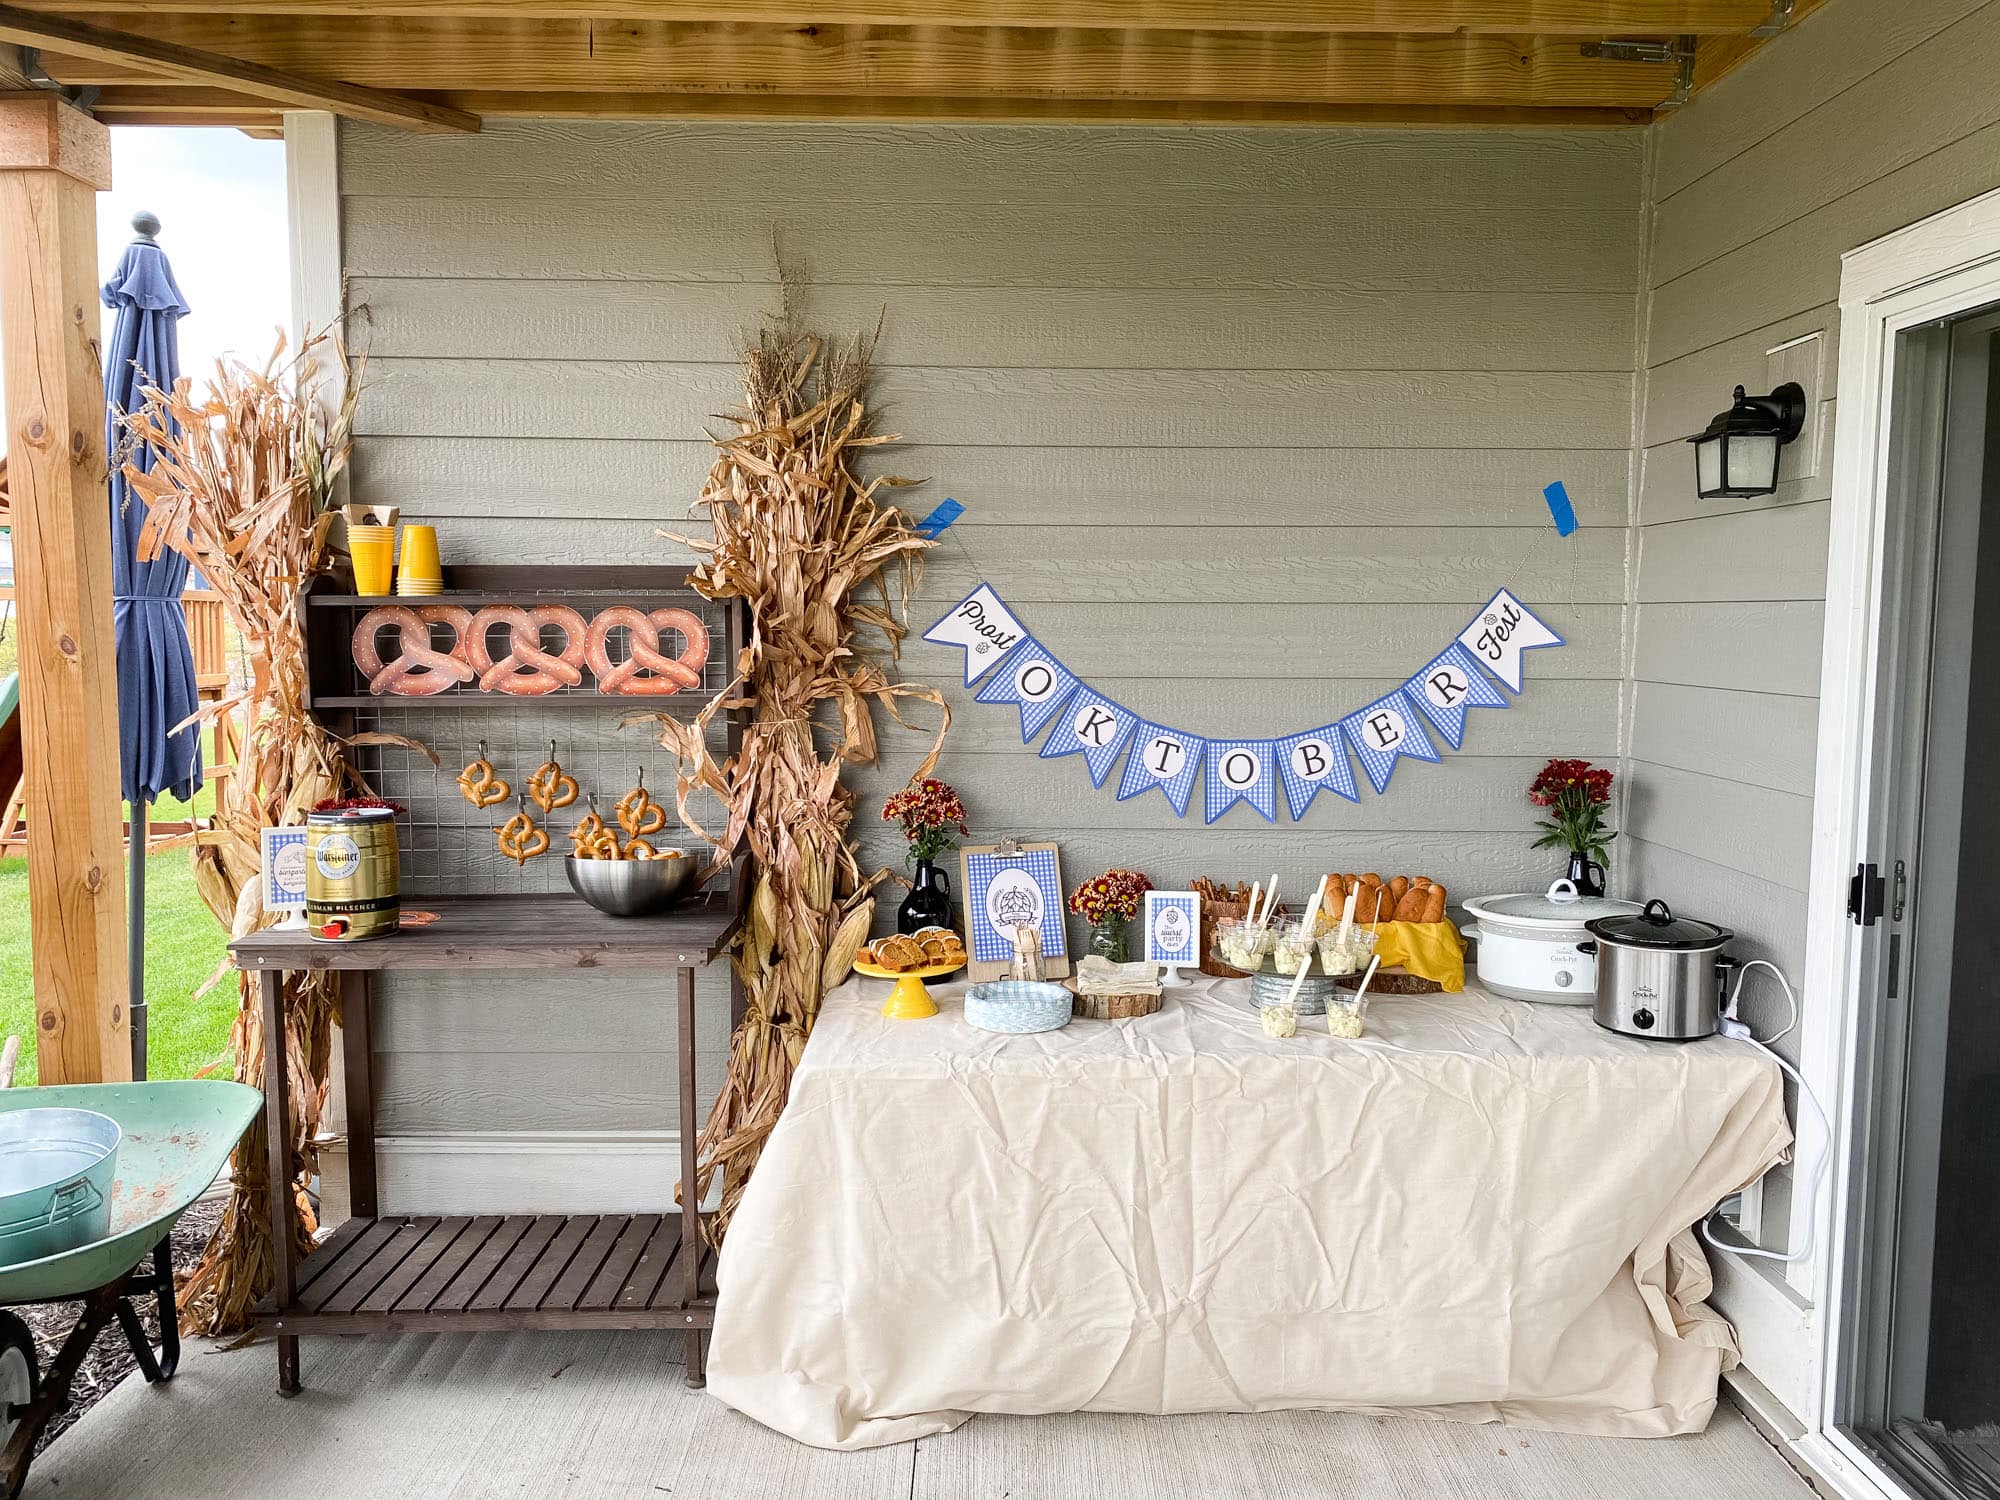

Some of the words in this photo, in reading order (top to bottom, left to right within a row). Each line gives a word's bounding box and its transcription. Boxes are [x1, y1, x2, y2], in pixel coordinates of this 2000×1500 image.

[958, 601, 1016, 649] Prost
[1477, 603, 1521, 660] Fest
[317, 850, 358, 863] Warsteiner
[336, 903, 376, 911] PILSENER
